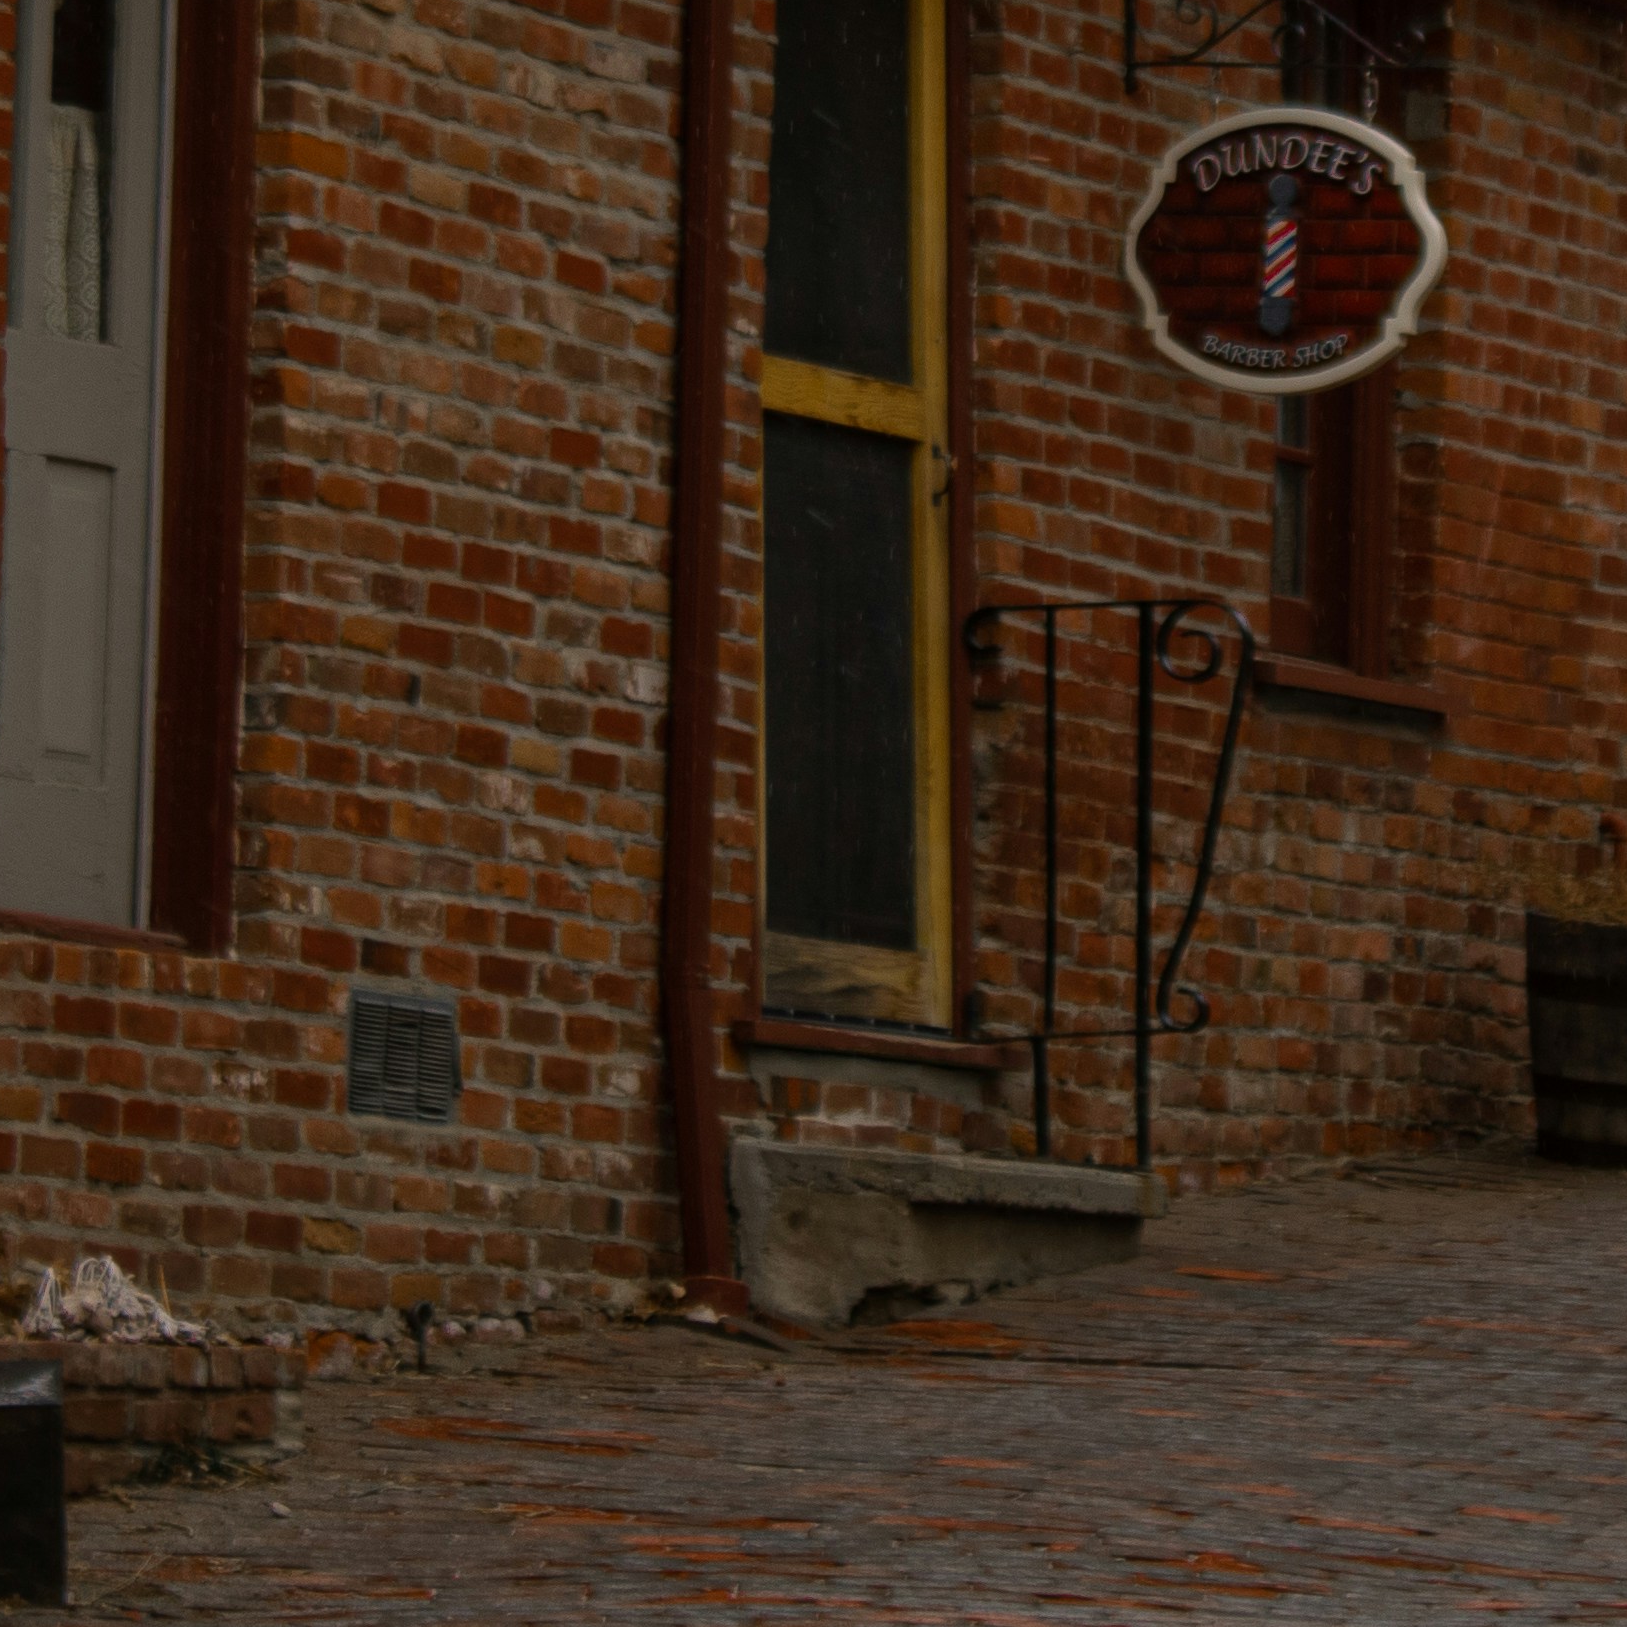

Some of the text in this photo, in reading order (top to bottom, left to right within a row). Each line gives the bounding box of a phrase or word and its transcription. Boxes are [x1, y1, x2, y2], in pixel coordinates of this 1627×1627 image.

[1191, 132, 1383, 196] DUNDEE'S
[1202, 334, 1348, 369] BARBER SHOP
